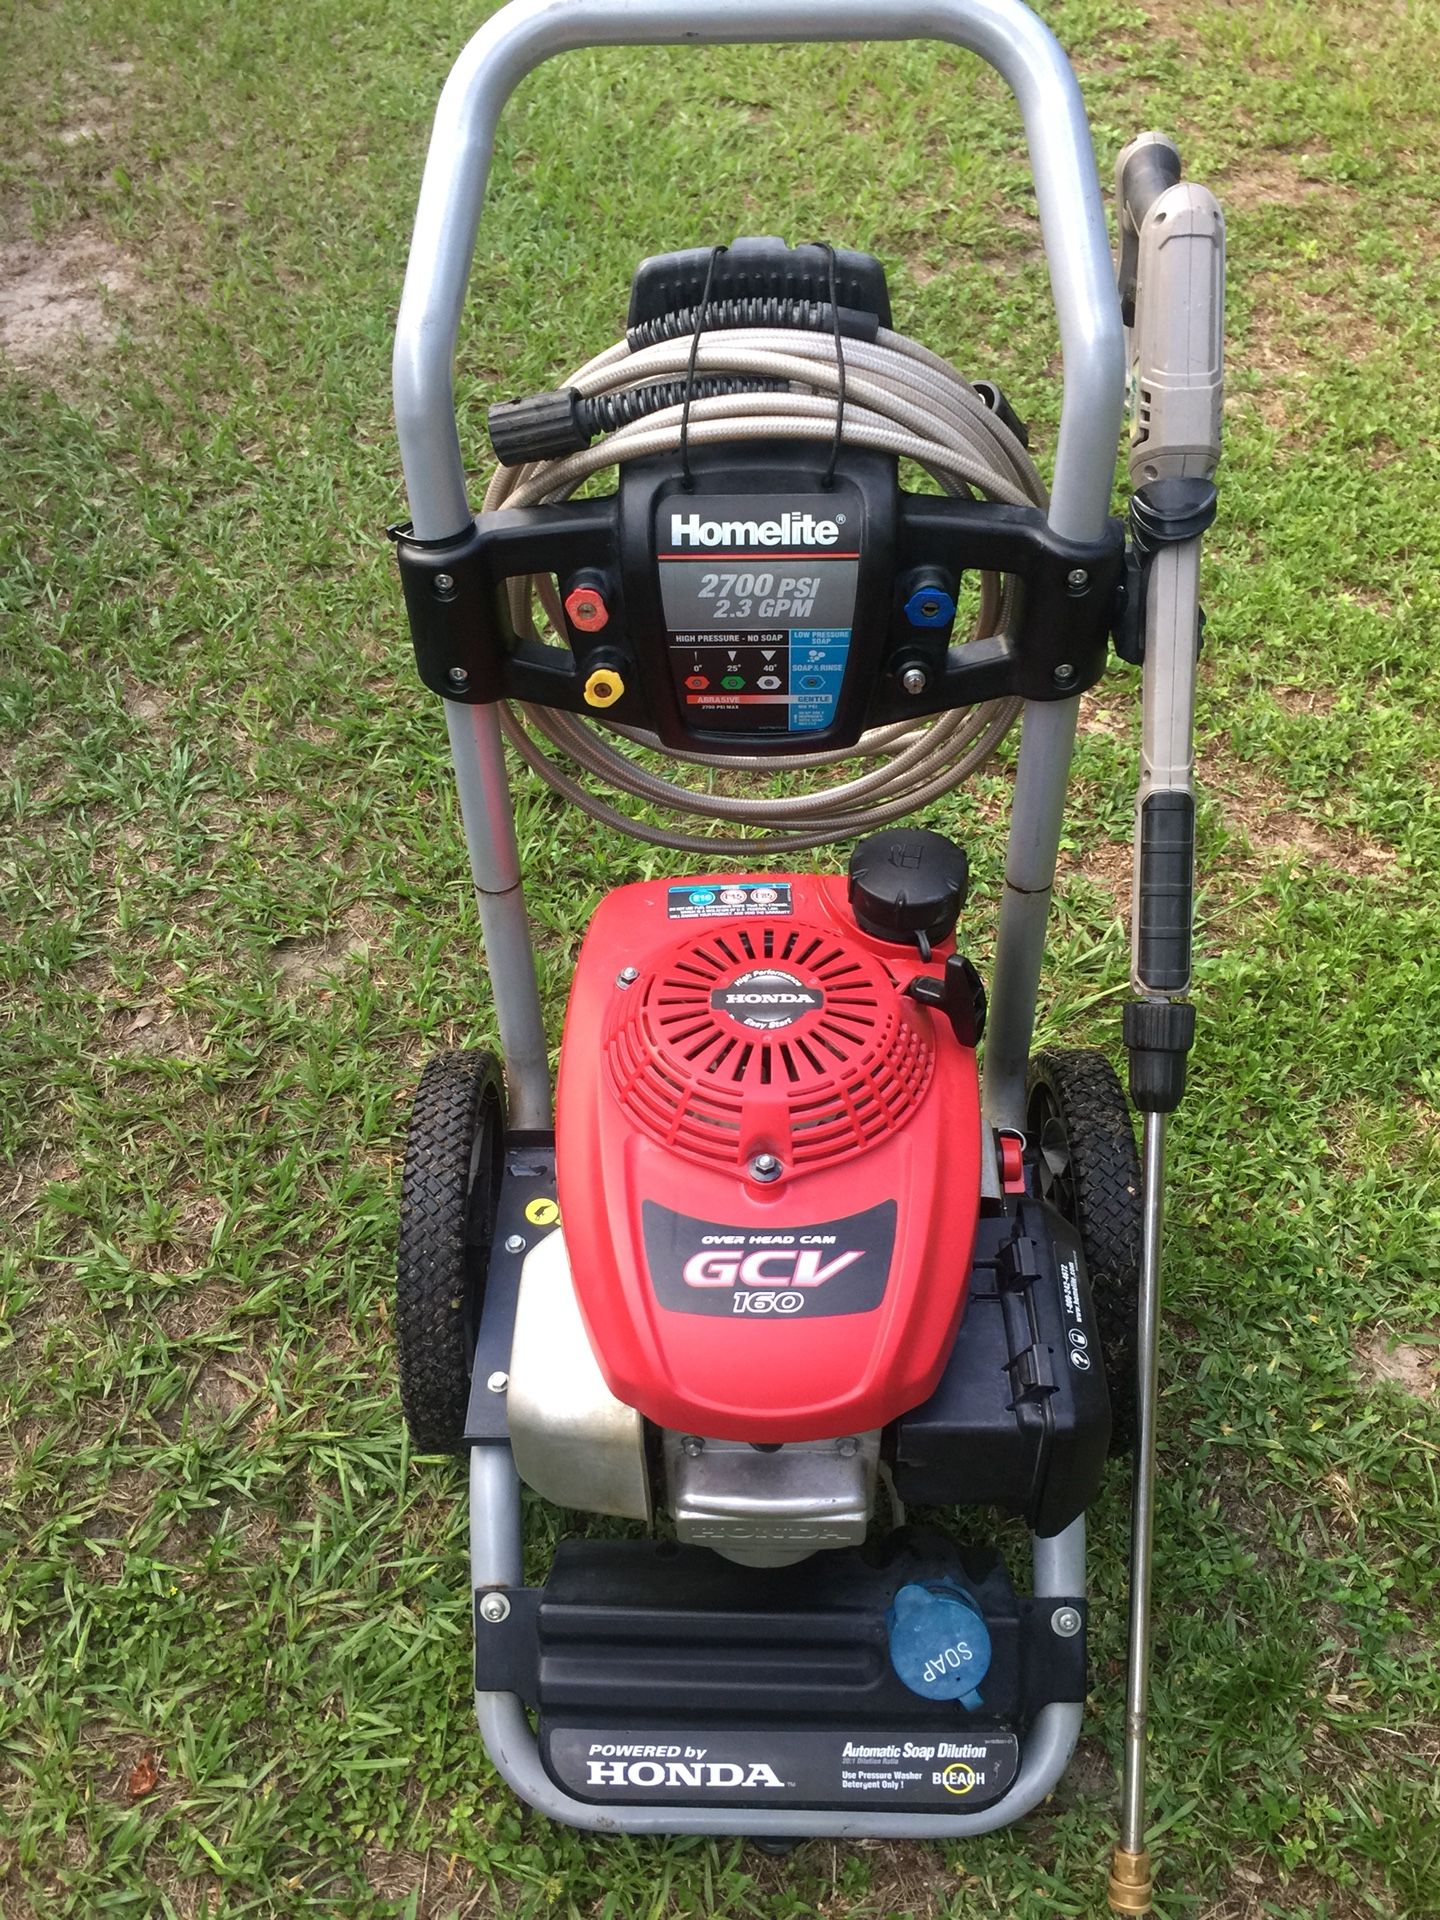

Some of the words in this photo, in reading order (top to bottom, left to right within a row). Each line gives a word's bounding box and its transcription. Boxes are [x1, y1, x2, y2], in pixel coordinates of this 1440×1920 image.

[698, 573, 774, 598] 2700
[777, 577, 821, 598] PSI
[713, 599, 751, 618] 2.3
[758, 599, 814, 618] GPM
[676, 634, 695, 643] HIGH
[697, 634, 740, 642] PRESSURE
[747, 634, 759, 642] NO
[761, 634, 783, 642] SOAP
[794, 631, 809, 639] LOW
[812, 631, 849, 639] PRESSURE
[792, 664, 813, 672] SOAP
[820, 664, 843, 672] RINSE
[697, 696, 740, 704] ABRASIVE
[734, 973, 752, 987] High
[753, 969, 803, 987] Performance
[725, 994, 815, 1004] HONDA
[743, 1017, 767, 1030] Easy
[768, 1017, 793, 1029] Start
[701, 1235, 745, 1245] OVER
[749, 1235, 796, 1245] HEAD
[799, 1235, 836, 1245] CAM
[683, 1249, 866, 1288] GCV
[733, 1291, 804, 1313] 160
[691, 1526, 852, 1540] HONDA
[923, 1641, 973, 1682] SOAP
[588, 1744, 681, 1758] POWERED
[684, 1745, 707, 1760] by
[842, 1741, 902, 1758] Automatic
[902, 1742, 935, 1761] Soap
[937, 1742, 987, 1759] Dilution
[586, 1760, 785, 1787] HONDA
[842, 1770, 857, 1780] Use
[858, 1770, 893, 1780] Pressure
[893, 1771, 923, 1780] Washer
[932, 1771, 986, 1786] BLEACH
[842, 1780, 881, 1790] Detergent
[881, 1780, 899, 1791] Only
